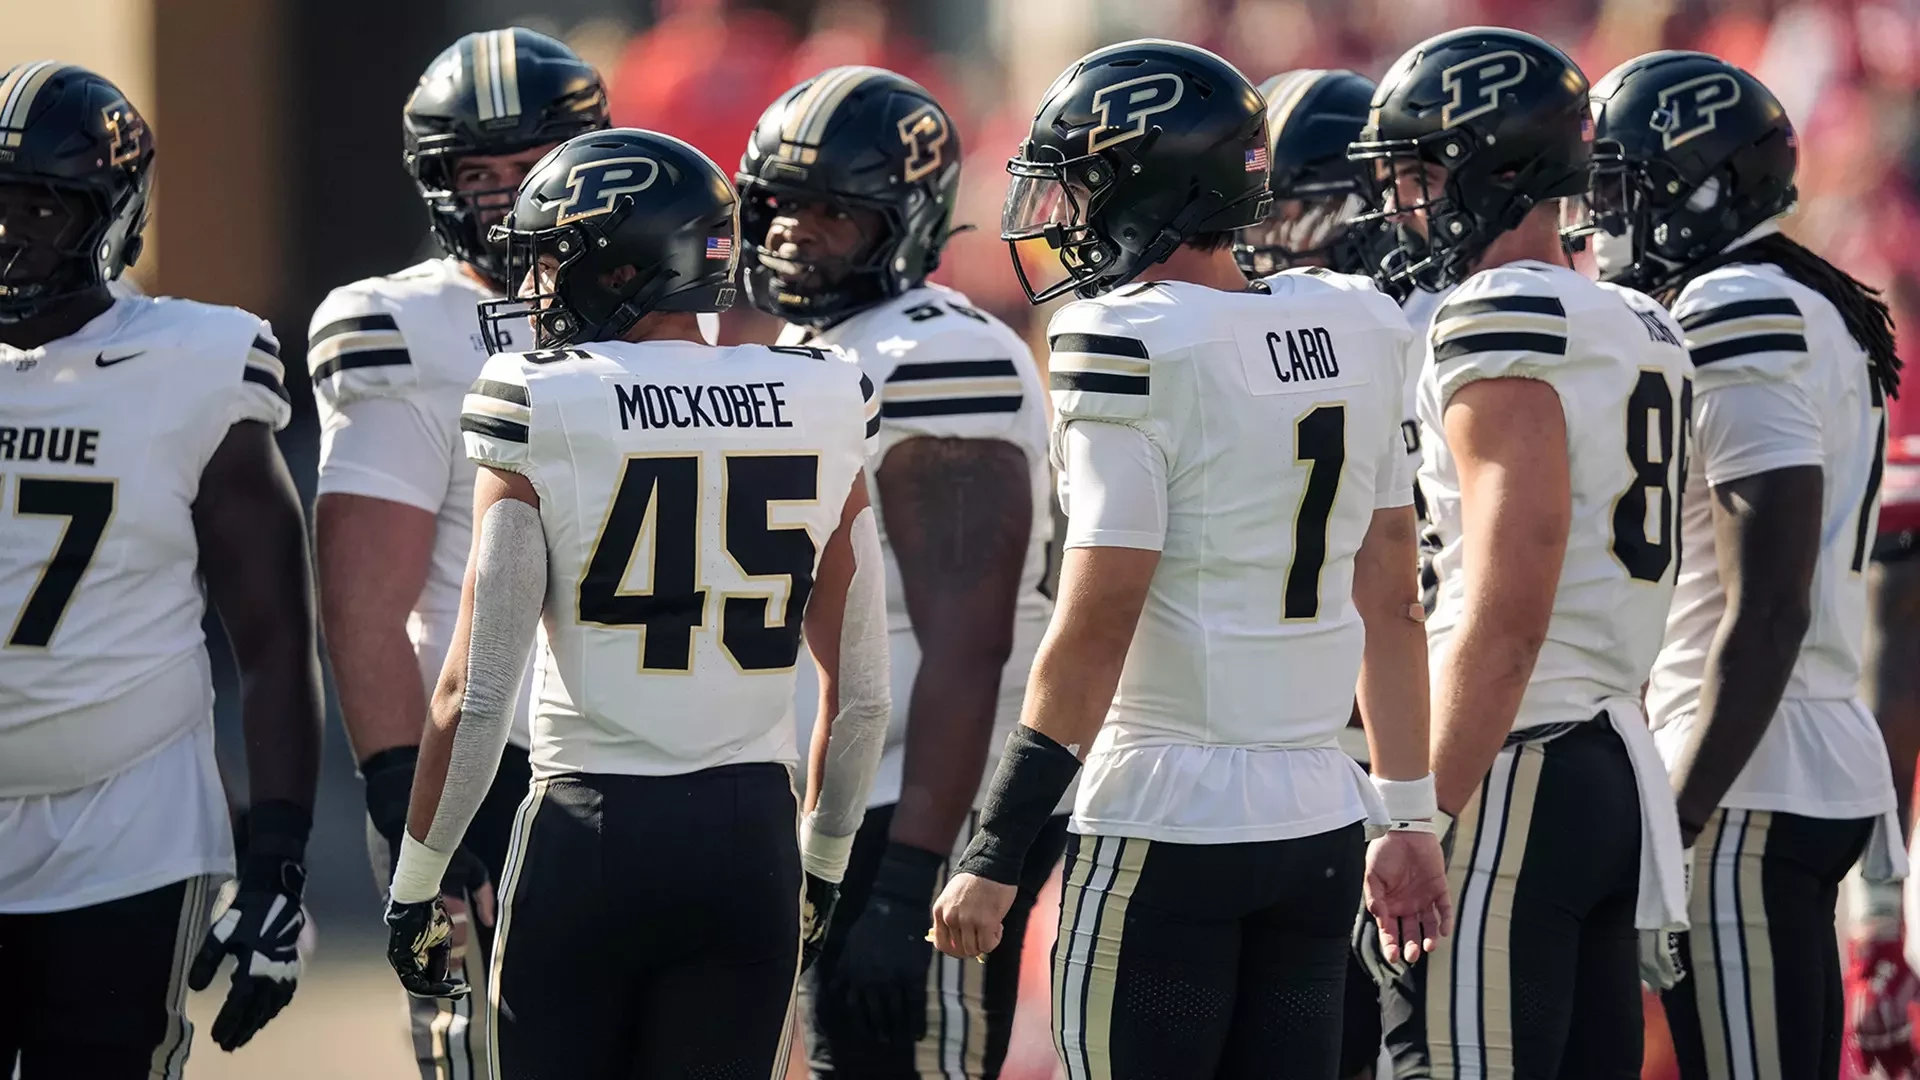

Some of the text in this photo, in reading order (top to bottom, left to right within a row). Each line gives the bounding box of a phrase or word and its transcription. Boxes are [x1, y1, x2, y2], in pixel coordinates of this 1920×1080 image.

[1087, 73, 1184, 154] P
[1442, 50, 1528, 131] P
[556, 155, 660, 226] P
[1266, 326, 1340, 383] CARD
[614, 382, 794, 431] MOCKOBEE
[1279, 400, 1348, 624] 1
[0, 472, 119, 651] 7
[575, 448, 823, 677] 45
